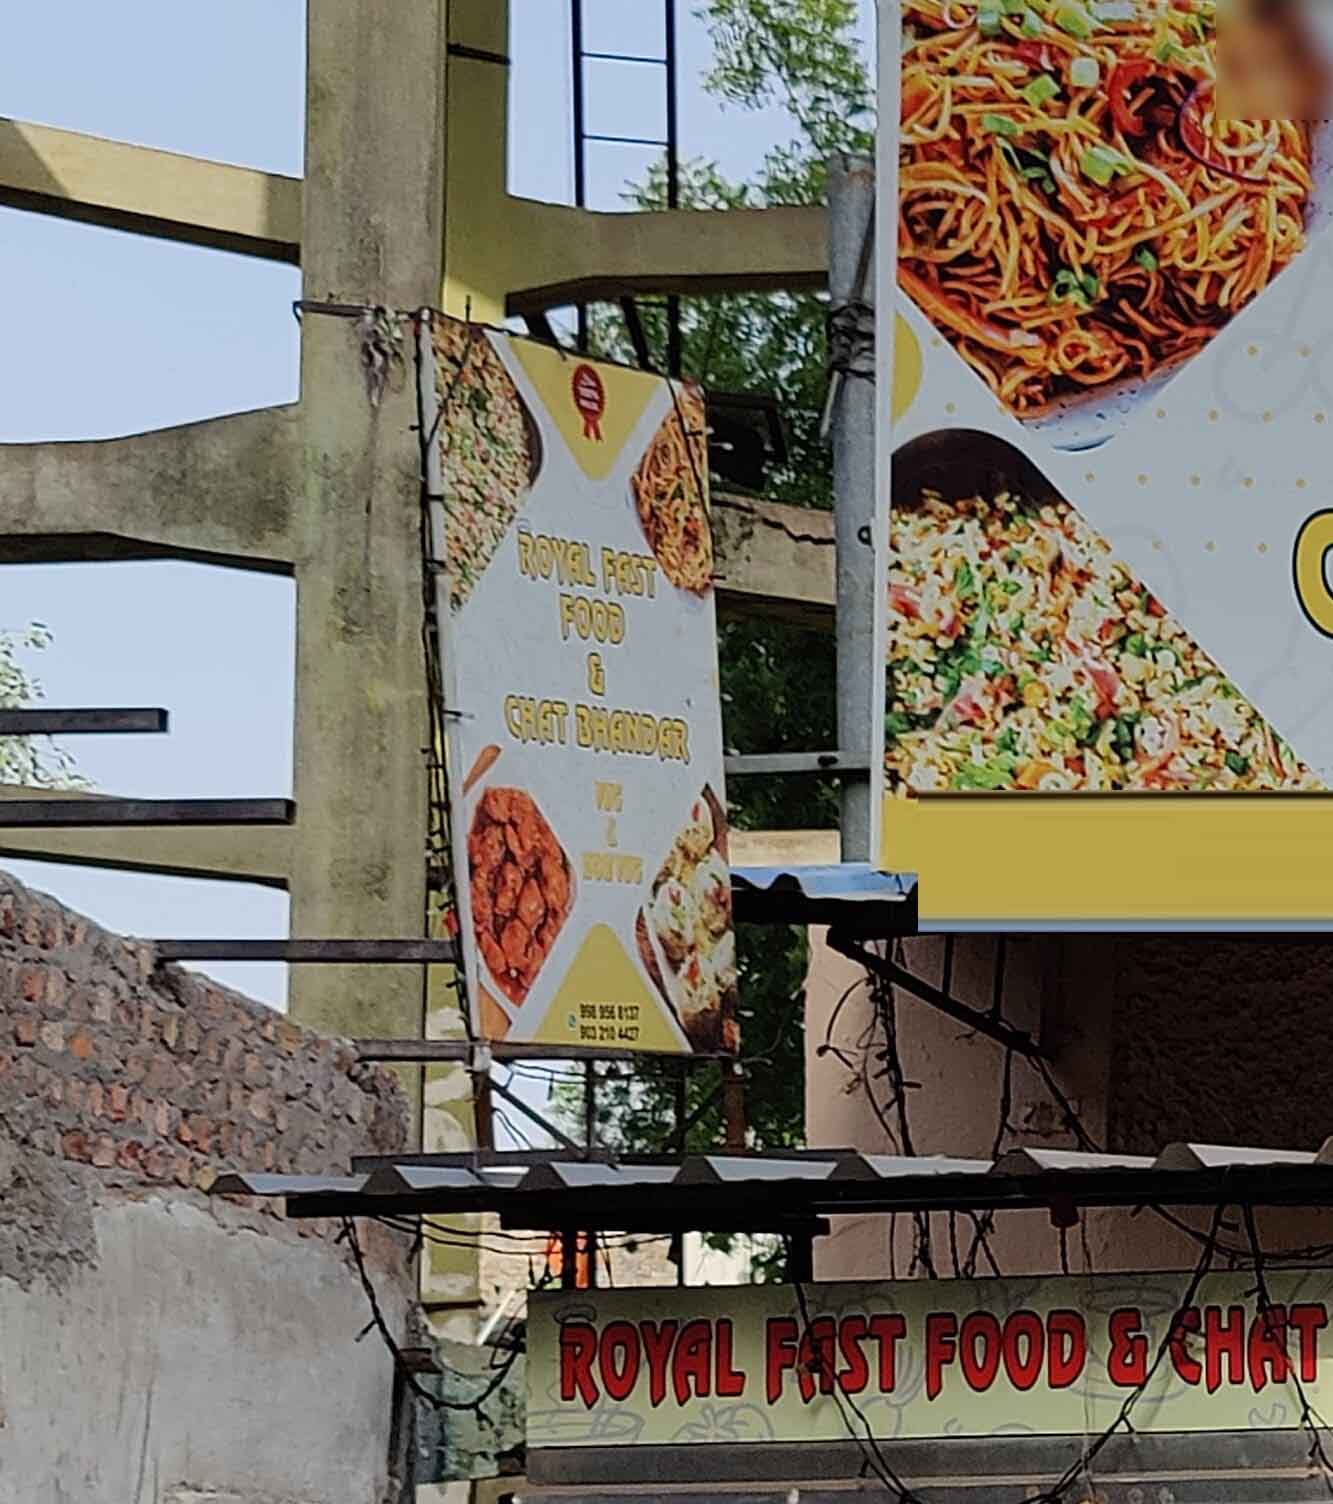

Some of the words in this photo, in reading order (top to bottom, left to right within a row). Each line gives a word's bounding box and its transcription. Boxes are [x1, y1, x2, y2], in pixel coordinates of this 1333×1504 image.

[518, 530, 596, 588] ROYAL
[601, 546, 657, 599] FAST
[559, 592, 625, 645] FOOD
[588, 652, 605, 696] &
[505, 694, 567, 746] CHAT
[575, 704, 689, 765] BHANDAR
[559, 1318, 744, 1409] ROYAL
[766, 1311, 906, 1406] FAST
[926, 1306, 1082, 1401] FOOD
[1106, 1304, 1150, 1389] &
[1171, 1302, 1332, 1391] CHAT
